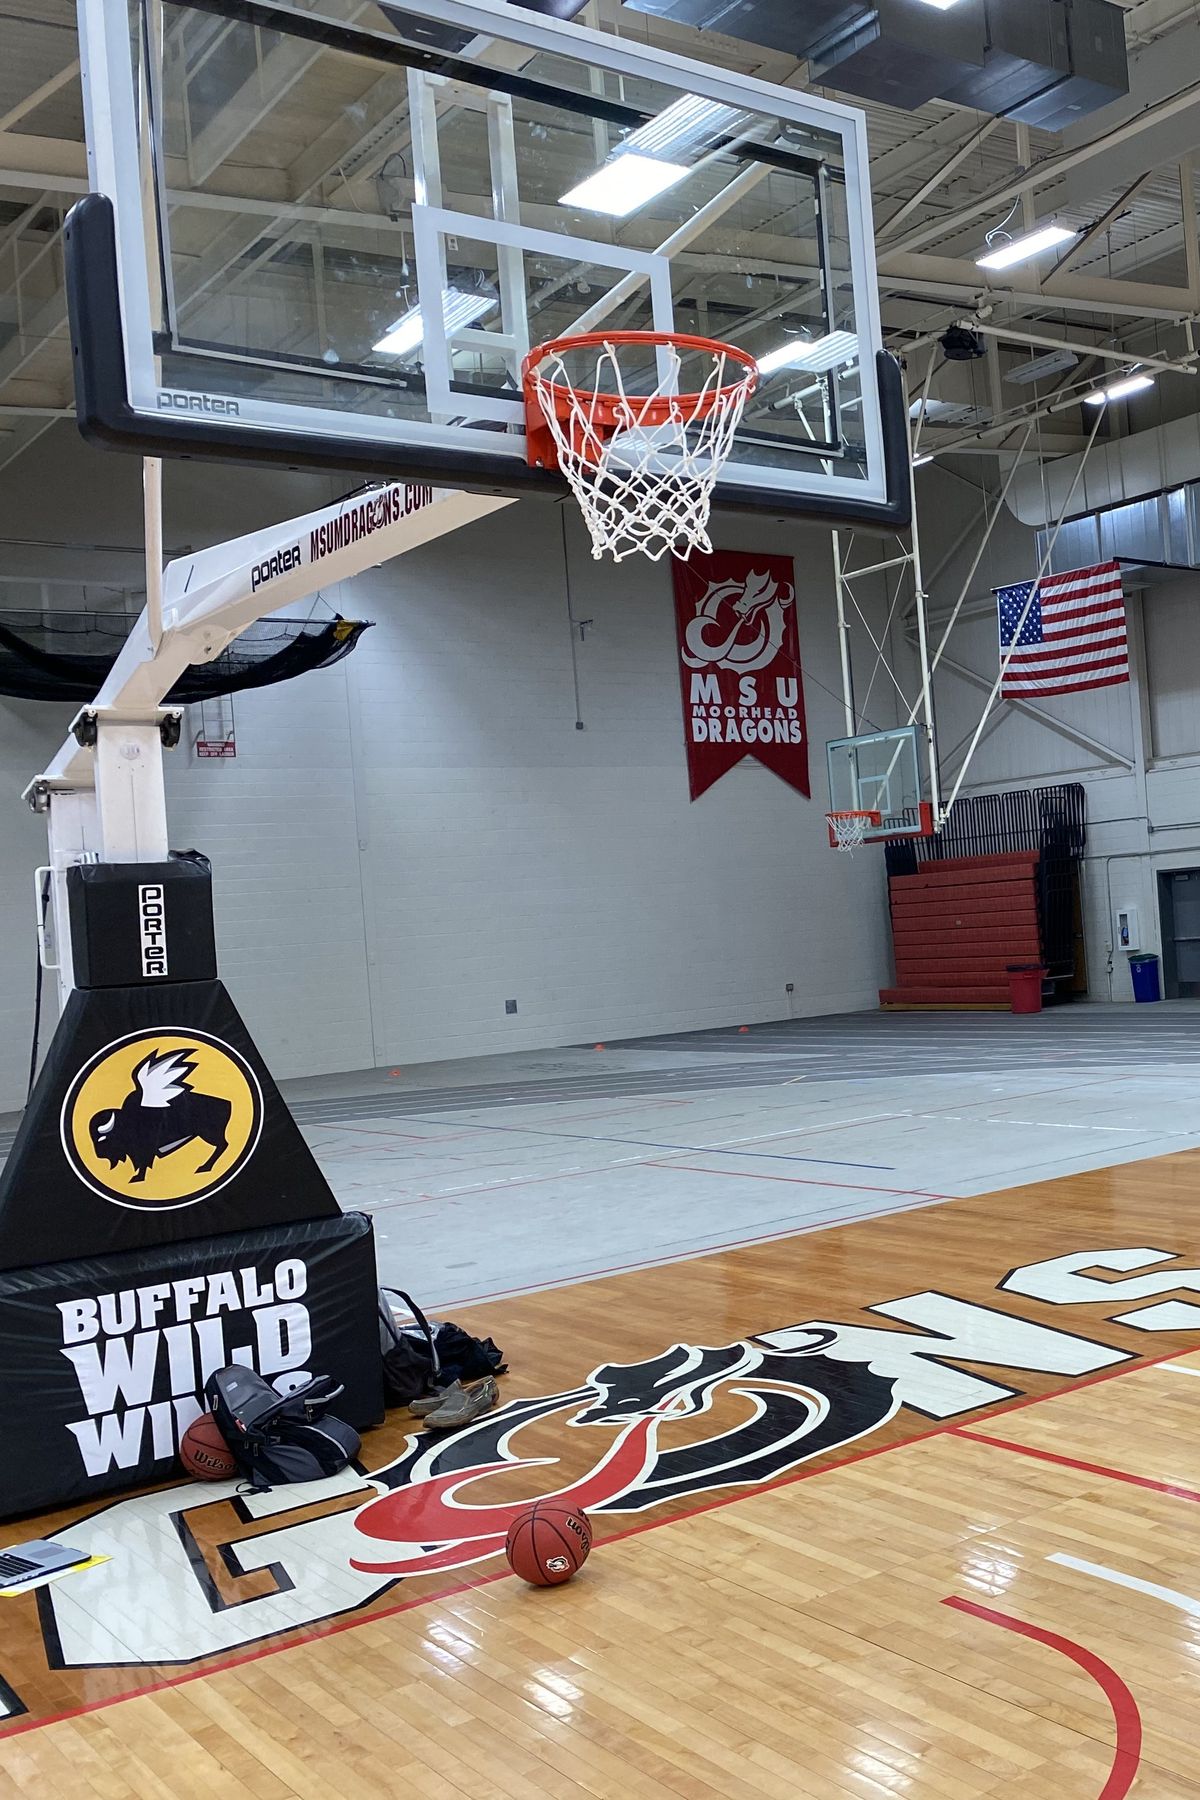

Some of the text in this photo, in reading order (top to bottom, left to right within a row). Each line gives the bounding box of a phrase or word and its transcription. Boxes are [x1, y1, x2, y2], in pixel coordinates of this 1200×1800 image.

[691, 717, 802, 744] DRAGONS
[692, 705, 798, 719] MOORHEAD
[56, 1258, 307, 1344] BUFFALO
[59, 1302, 312, 1415] WILD
